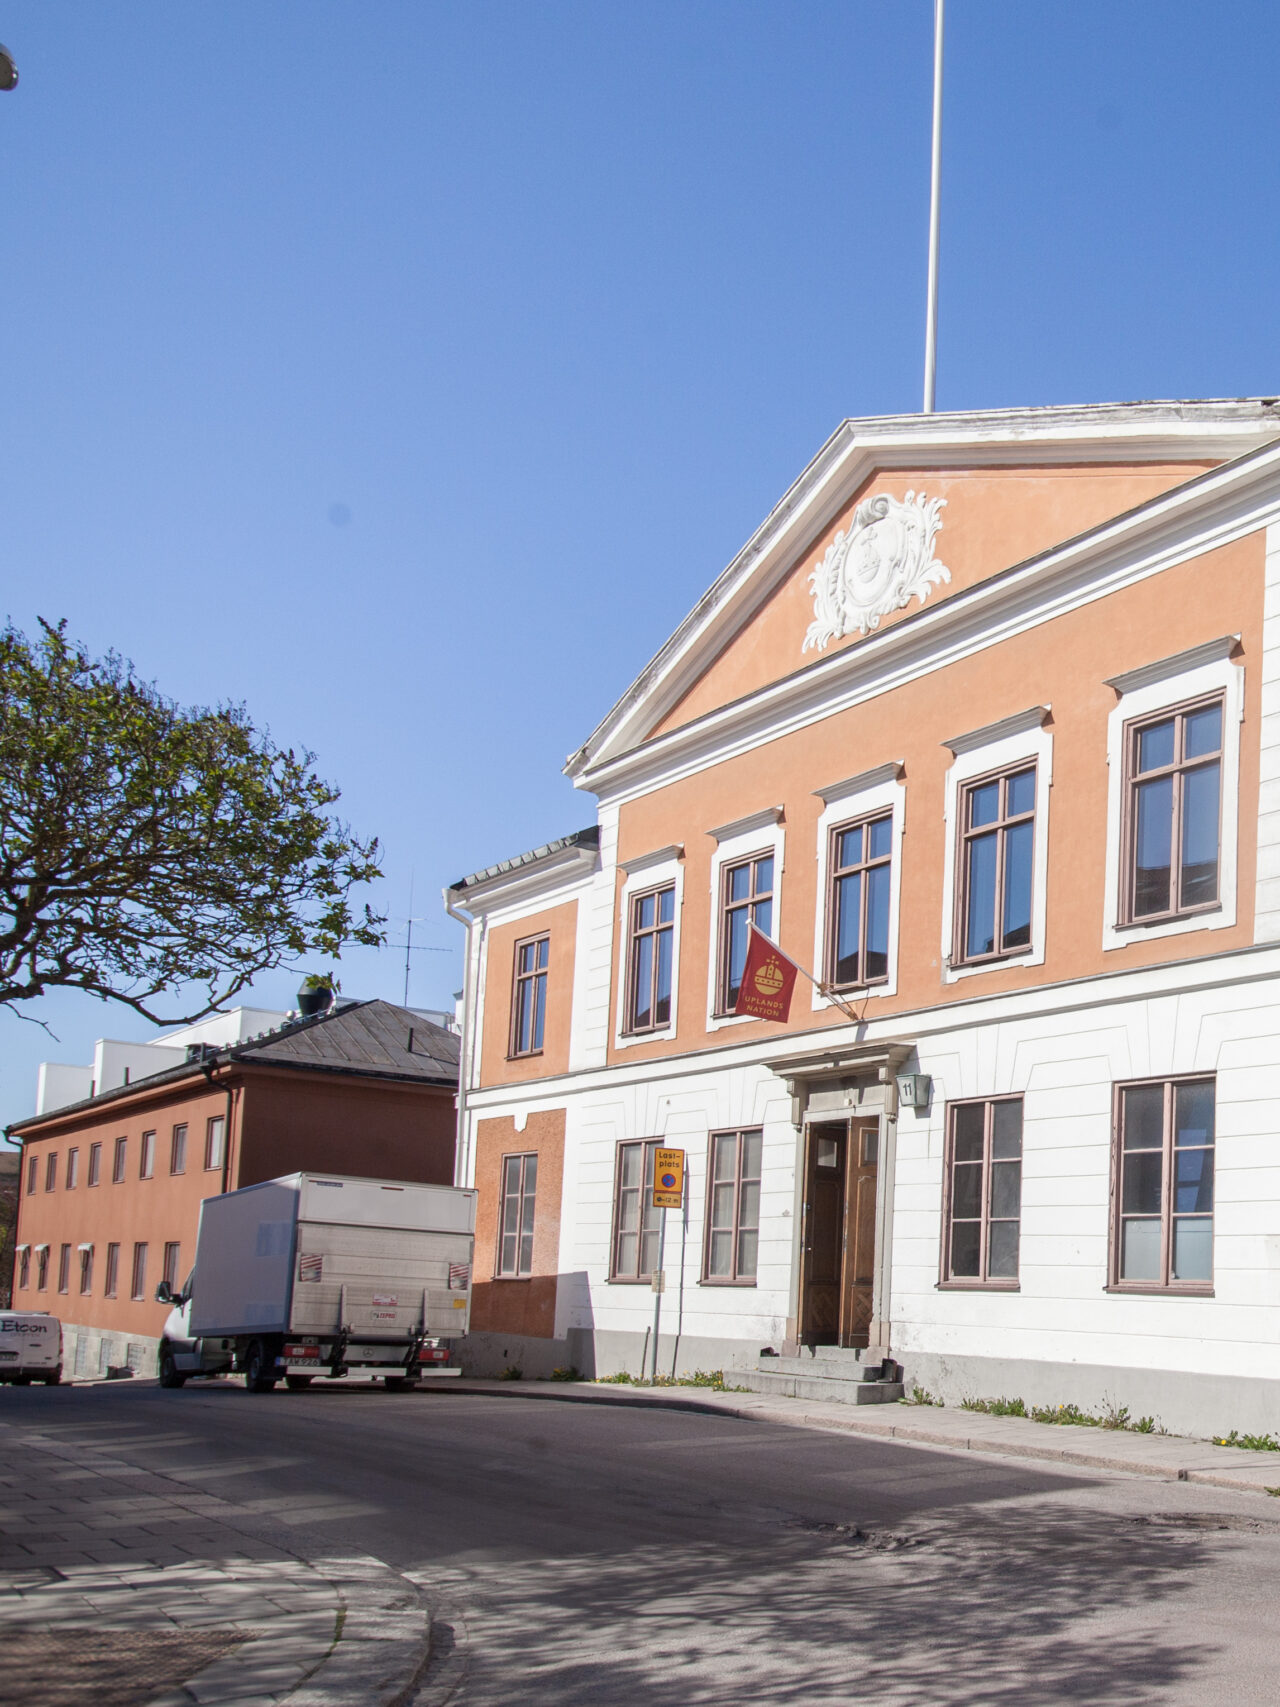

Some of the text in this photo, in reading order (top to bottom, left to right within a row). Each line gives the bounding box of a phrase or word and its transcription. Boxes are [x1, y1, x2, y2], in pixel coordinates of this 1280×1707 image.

[744, 995, 784, 1009] UPLANDS
[746, 1004, 780, 1017] NATION
[902, 1082, 912, 1096] 11
[658, 1151, 681, 1160] Last-
[659, 1160, 680, 1169] plats
